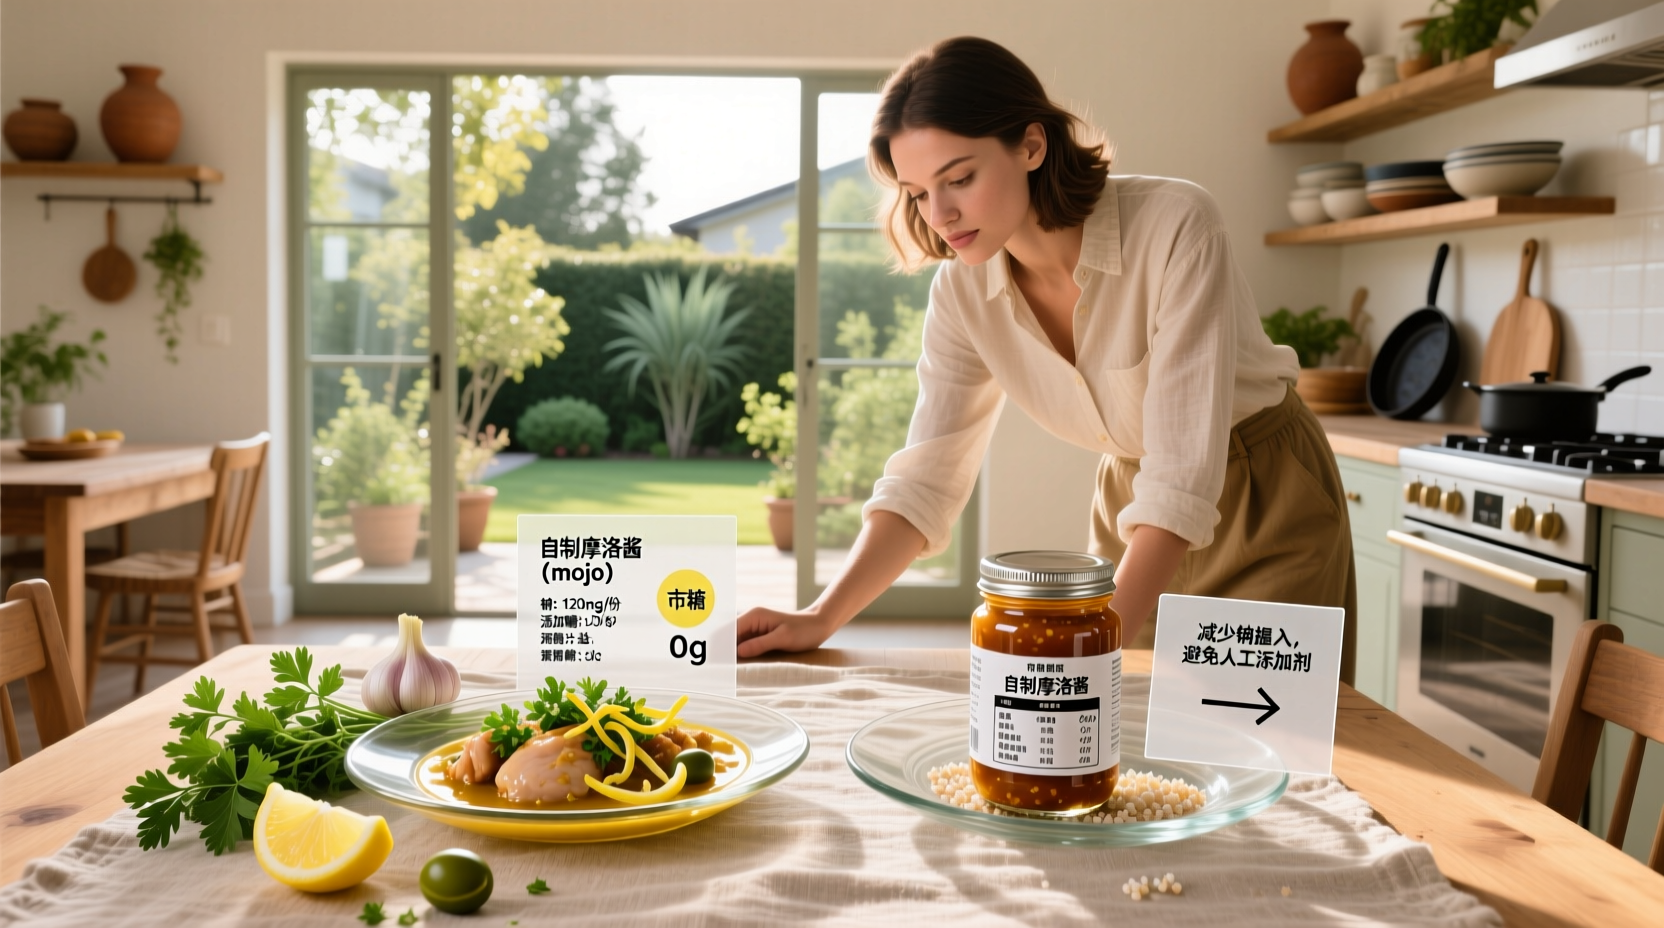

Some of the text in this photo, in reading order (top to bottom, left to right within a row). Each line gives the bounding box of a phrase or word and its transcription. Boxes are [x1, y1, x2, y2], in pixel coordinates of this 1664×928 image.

[541, 536, 642, 560] 自制摩洛酱
[542, 561, 613, 586] (mojo)
[669, 634, 707, 666] 0g
[1005, 674, 1089, 697] 自制摩洛酱
